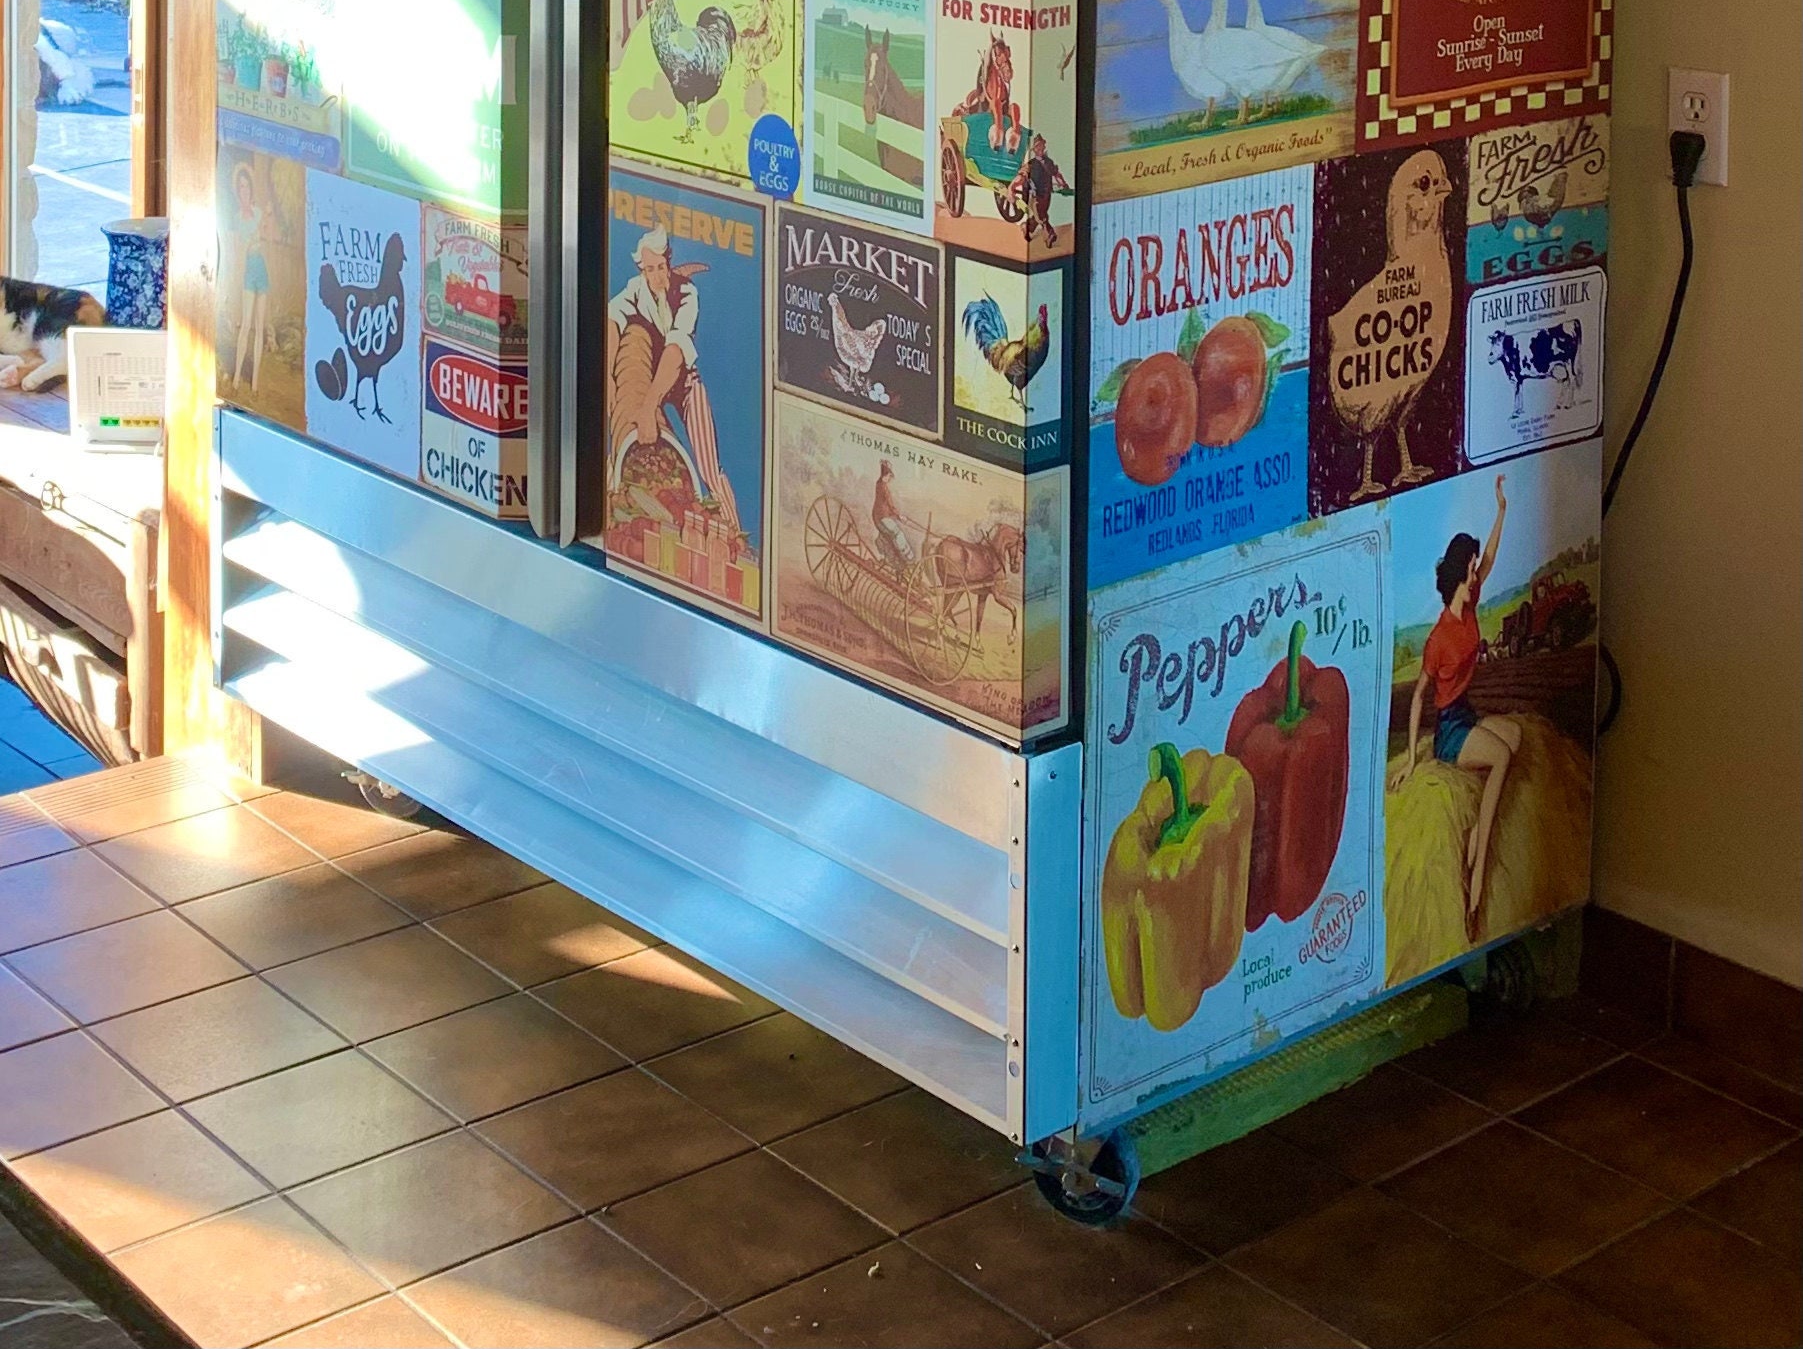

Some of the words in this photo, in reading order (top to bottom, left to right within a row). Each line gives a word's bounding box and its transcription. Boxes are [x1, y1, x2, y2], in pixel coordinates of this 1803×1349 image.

[979, 0, 1071, 31] STRENGTH
[1473, 14, 1505, 37] Open
[1437, 34, 1487, 58] Sunrise
[1499, 23, 1545, 46] Sunset
[1456, 53, 1493, 73] Every
[1497, 46, 1523, 67] Day
[754, 138, 795, 160] POULTRY
[769, 155, 779, 172] &
[1236, 137, 1285, 165] Organic
[1478, 131, 1531, 169] FARM
[759, 170, 789, 192] EGGS
[896, 197, 921, 215] WORLD
[319, 221, 382, 263] FARM
[444, 220, 472, 236] FARM
[475, 224, 510, 253] FRESH
[339, 257, 379, 285] FRESH
[785, 224, 934, 310] MARKET
[1108, 203, 1295, 326] ORANGES
[1385, 264, 1416, 284] FARM
[1483, 240, 1595, 280] EGGS
[785, 283, 824, 314] ORGANIC
[832, 268, 880, 303] Fresh
[1377, 280, 1422, 302] BUREAU
[1481, 293, 1513, 324] FARM
[1516, 286, 1556, 316] FRESH
[1560, 280, 1591, 308] MILK
[345, 293, 399, 355] Eggs
[785, 309, 807, 336] EGGS
[1355, 300, 1433, 347] CO-OP
[896, 344, 931, 375] SPECIAL
[1337, 337, 1434, 391] CHICKS
[439, 362, 528, 421] BEWARE
[468, 437, 486, 459] OF
[850, 432, 900, 458] THOMAS
[907, 450, 935, 469] HAY
[956, 416, 985, 438] THE
[986, 426, 1028, 451] COCK
[1030, 430, 1058, 450] INN
[1103, 485, 1176, 538] REDWOOD
[1185, 465, 1245, 512] ORANGE
[1148, 519, 1203, 556] REDLANDS
[1212, 503, 1255, 536] FLORIDA
[1108, 573, 1322, 745] Peppers
[1299, 890, 1367, 965] GUARANTEED
[1242, 948, 1275, 978] Local
[1243, 964, 1292, 1004] produce
